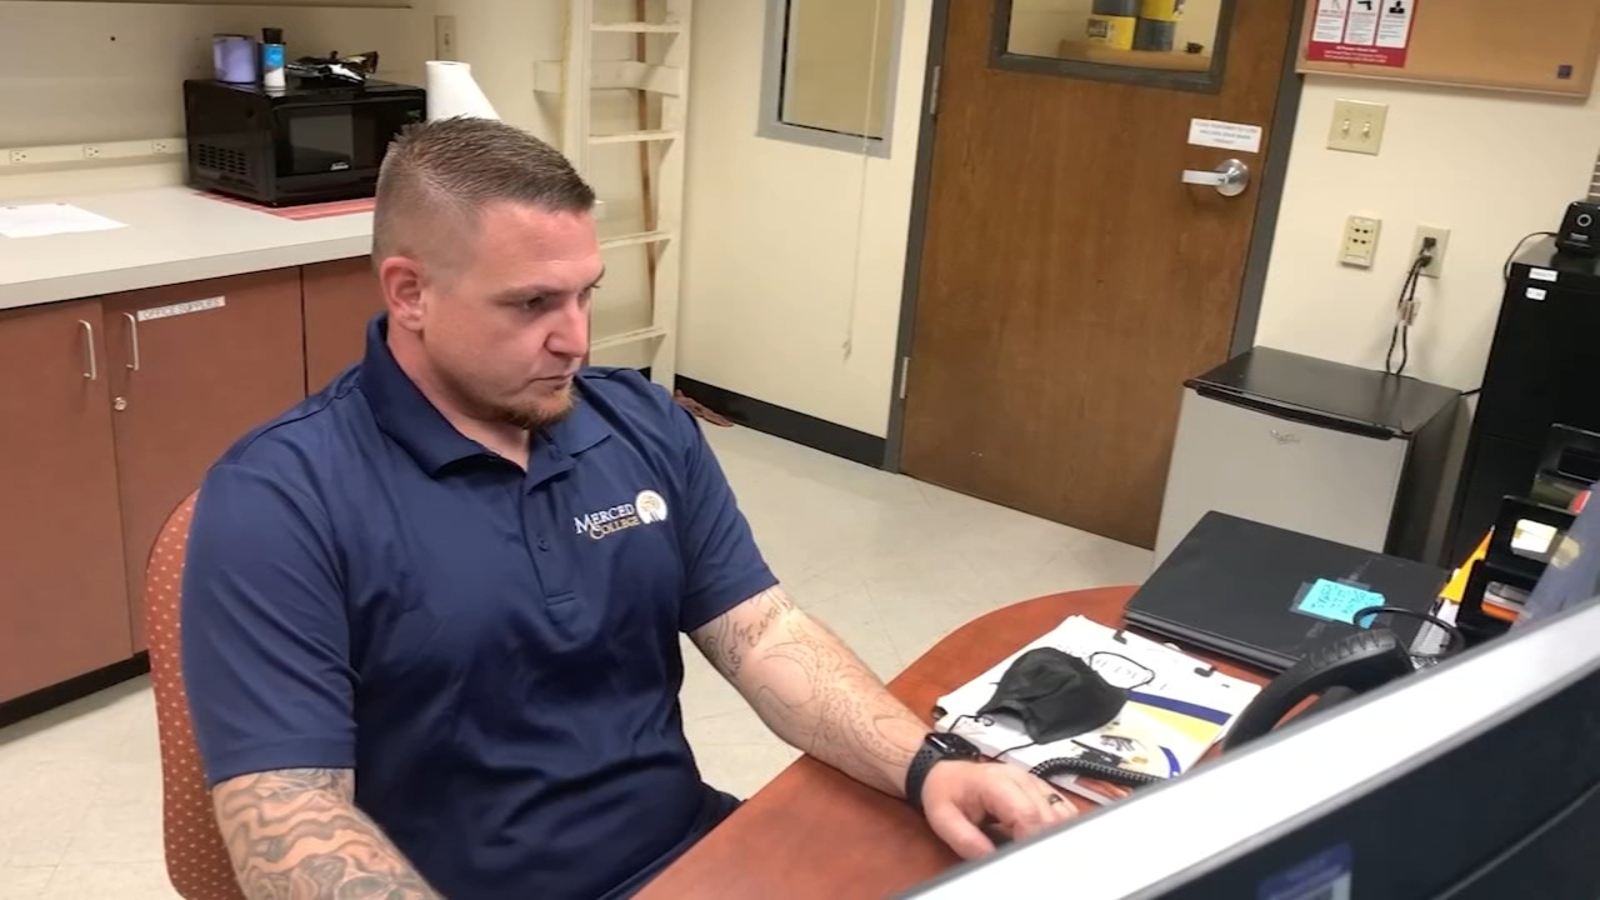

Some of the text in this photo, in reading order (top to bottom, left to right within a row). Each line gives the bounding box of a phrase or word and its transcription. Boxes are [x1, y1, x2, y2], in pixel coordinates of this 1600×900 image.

[144, 298, 220, 319] OFFICE SUPPLIES
[574, 503, 635, 534] MERCED
[590, 515, 640, 539] COLLEGE
